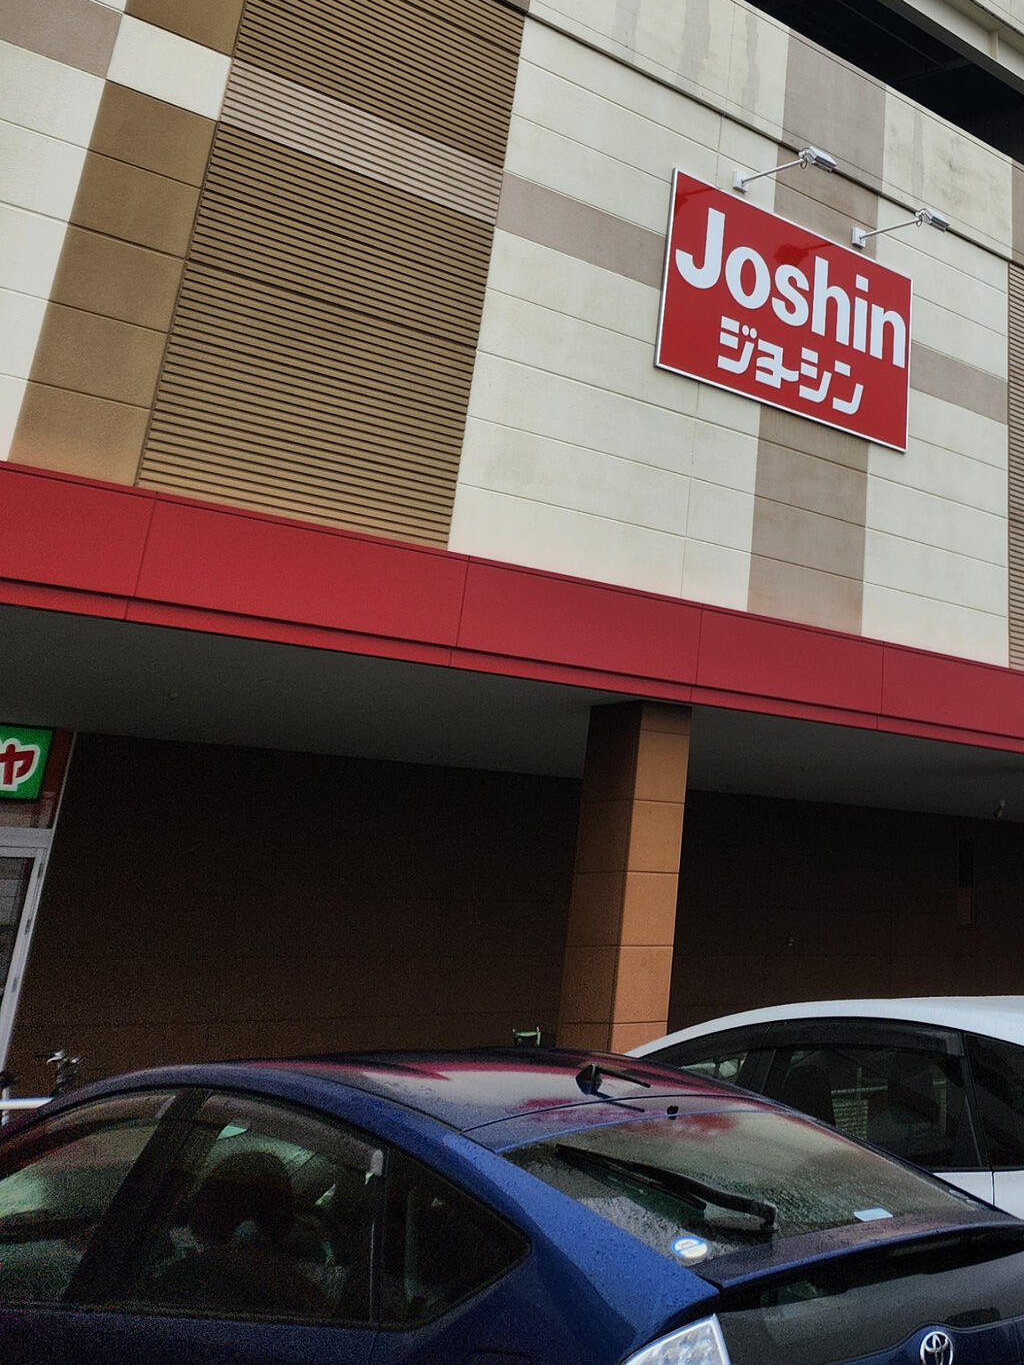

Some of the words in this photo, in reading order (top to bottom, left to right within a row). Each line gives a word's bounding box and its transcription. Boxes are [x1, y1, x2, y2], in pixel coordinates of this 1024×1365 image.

[675, 206, 907, 369] Joshin
[716, 315, 865, 416] ジョーシン
